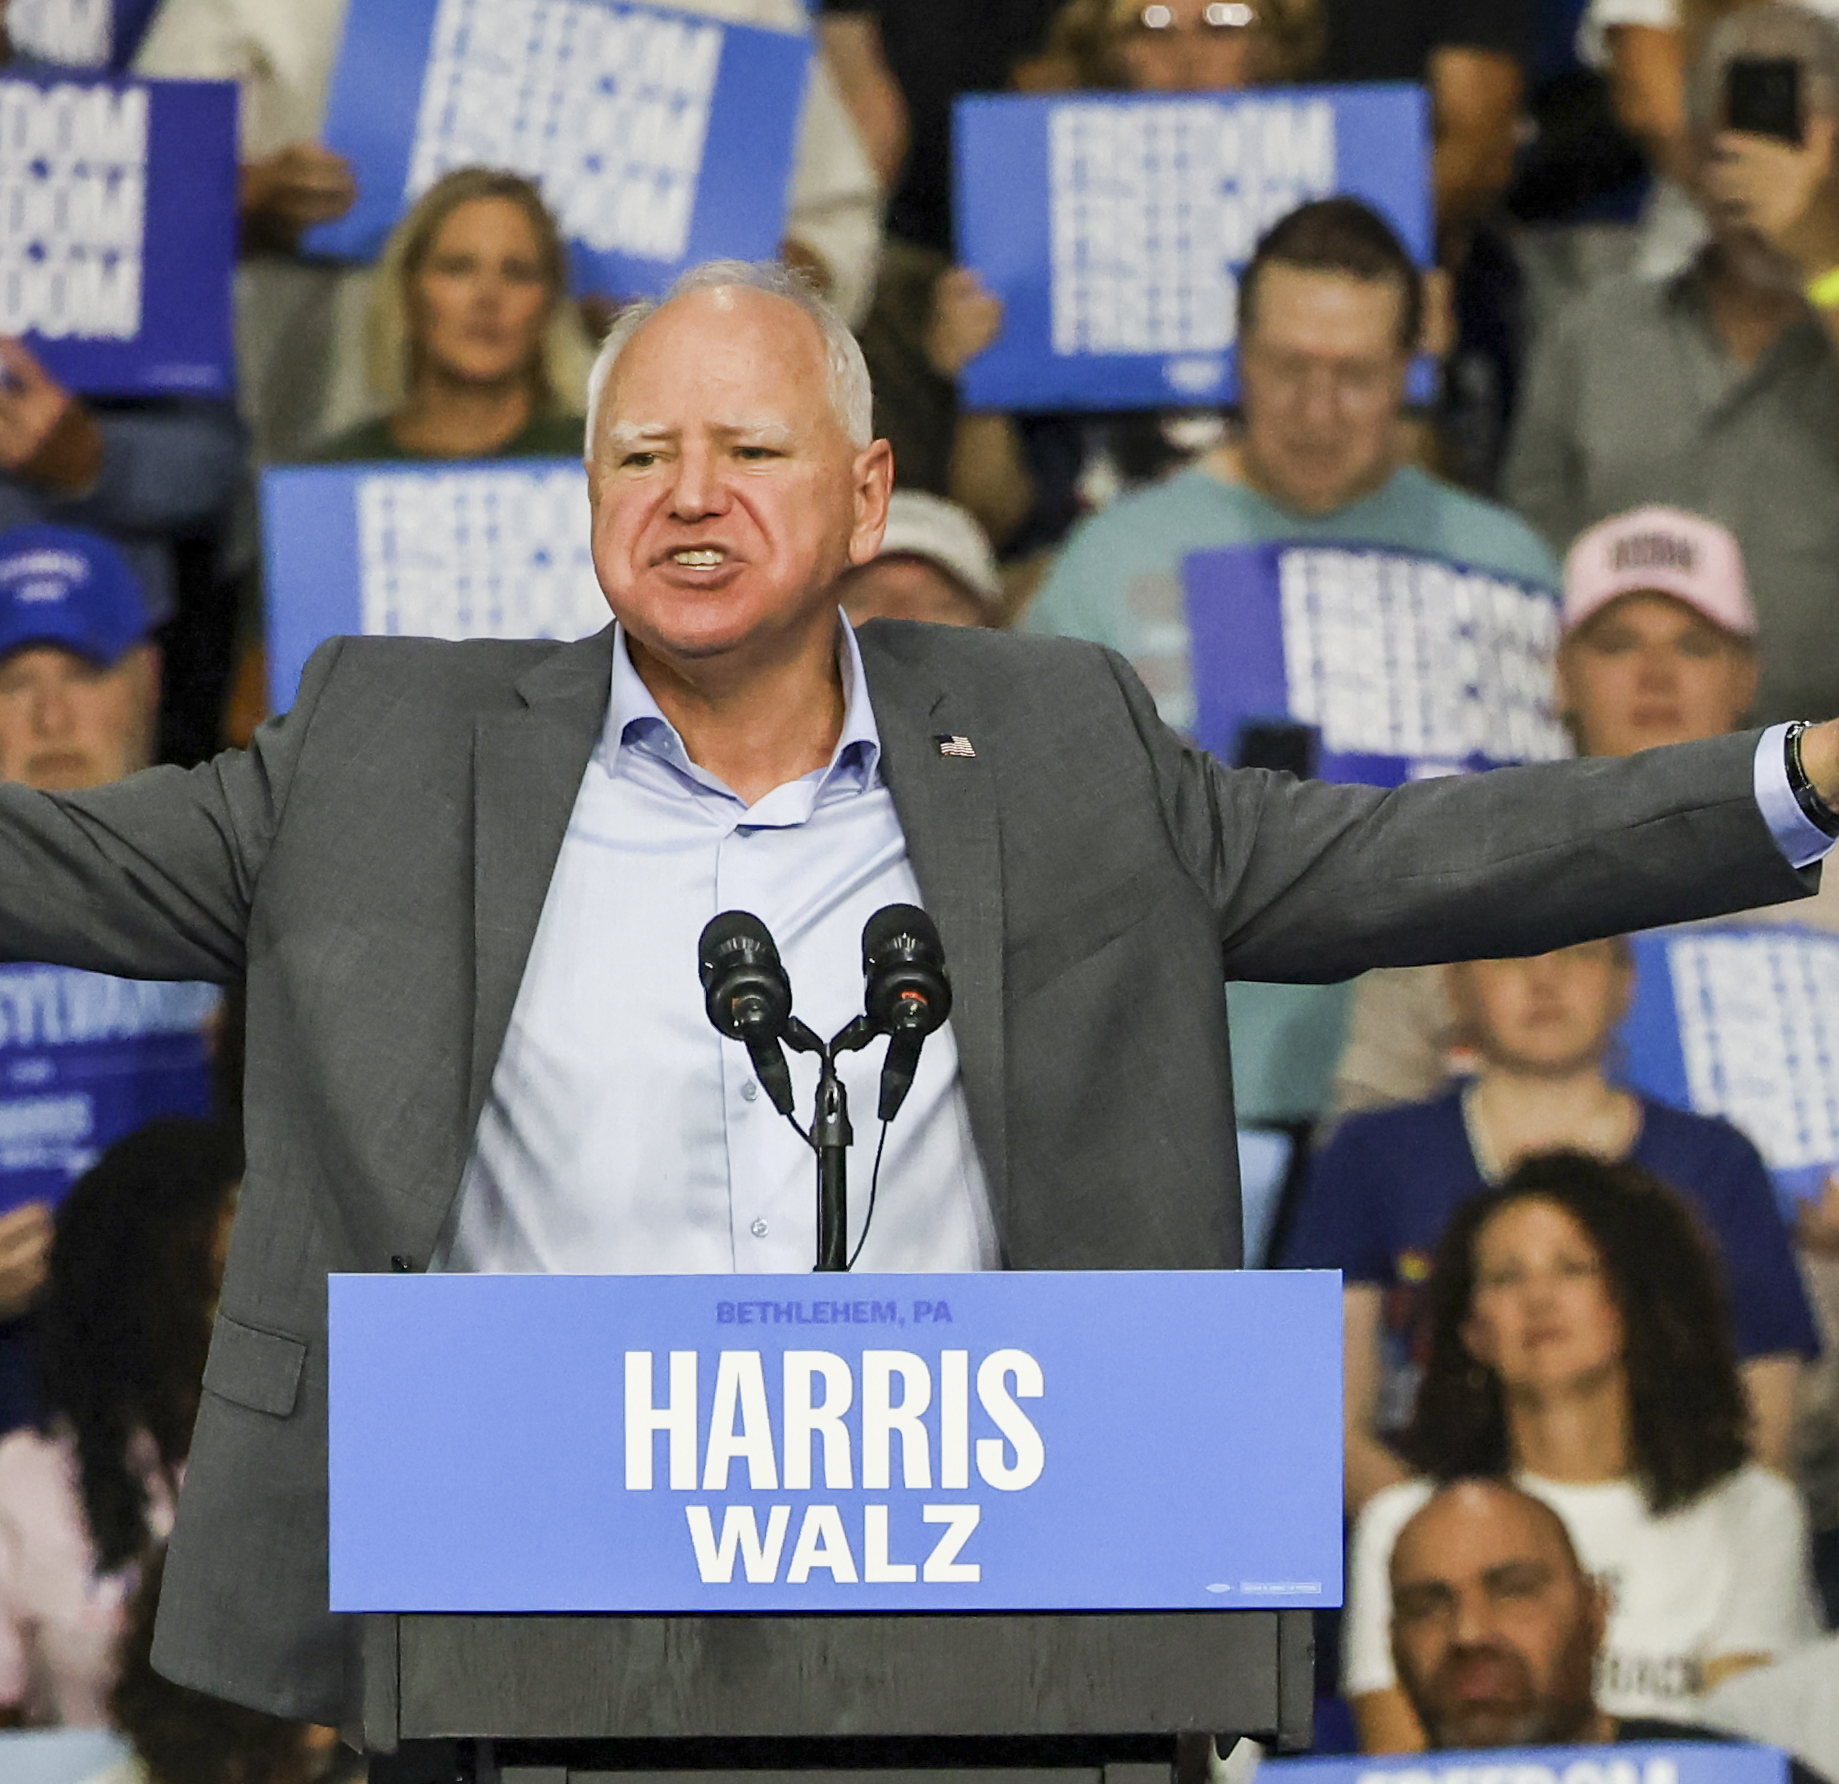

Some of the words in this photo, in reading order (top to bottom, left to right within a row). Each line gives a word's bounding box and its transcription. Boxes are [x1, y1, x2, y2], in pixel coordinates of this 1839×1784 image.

[716, 1301, 905, 1328] BETHLEHEM,
[913, 1300, 953, 1324] PA
[625, 1349, 1045, 1492] HARRIS
[685, 1504, 981, 1583] WALZ
